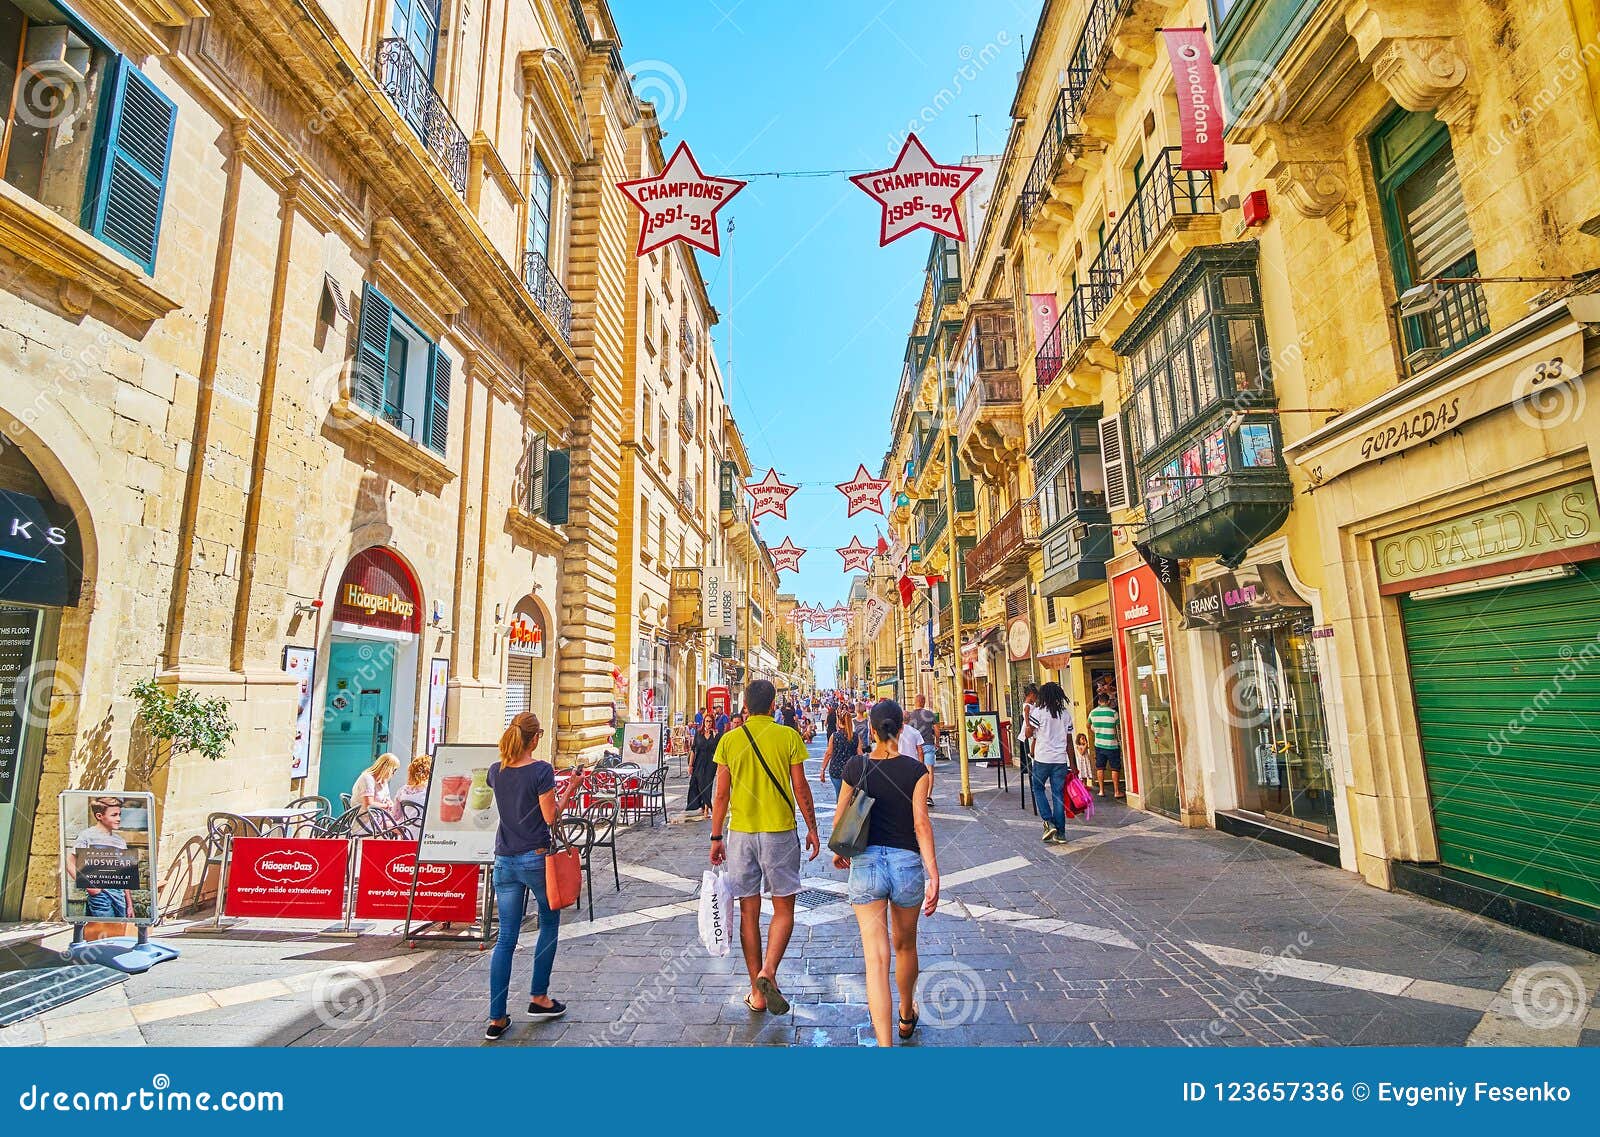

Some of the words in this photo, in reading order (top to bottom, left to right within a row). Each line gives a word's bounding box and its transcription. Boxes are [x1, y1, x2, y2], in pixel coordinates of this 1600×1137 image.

[1187, 64, 1210, 144] vodafone
[637, 182, 724, 202] CHAMPIONS
[873, 171, 961, 195] CHAMPIONS
[647, 204, 712, 235] 1991-92
[887, 197, 952, 225] 1996-97
[1532, 356, 1564, 385] 33
[1361, 398, 1460, 459] GOPALDAS
[753, 486, 789, 496] CHAMPIONS
[844, 482, 882, 494] CHAMPIONS
[756, 497, 784, 511] 1997-98
[851, 494, 879, 509] 1998-99
[1382, 492, 1592, 578] GOPALDAS
[343, 584, 414, 615] Häagen-Dazs
[1190, 595, 1219, 615] FRANKS
[1124, 604, 1149, 620] vodafone
[11, 627, 31, 635] FLOOR
[84, 858, 132, 867] KIDSWEAR
[261, 860, 313, 873] Häagen-Dazs
[392, 863, 446, 875] Häagn-Dazs
[237, 885, 267, 895] everyday
[367, 888, 399, 898] everyday
[400, 888, 419, 897] mäe
[711, 893, 724, 945] TOPMAN
